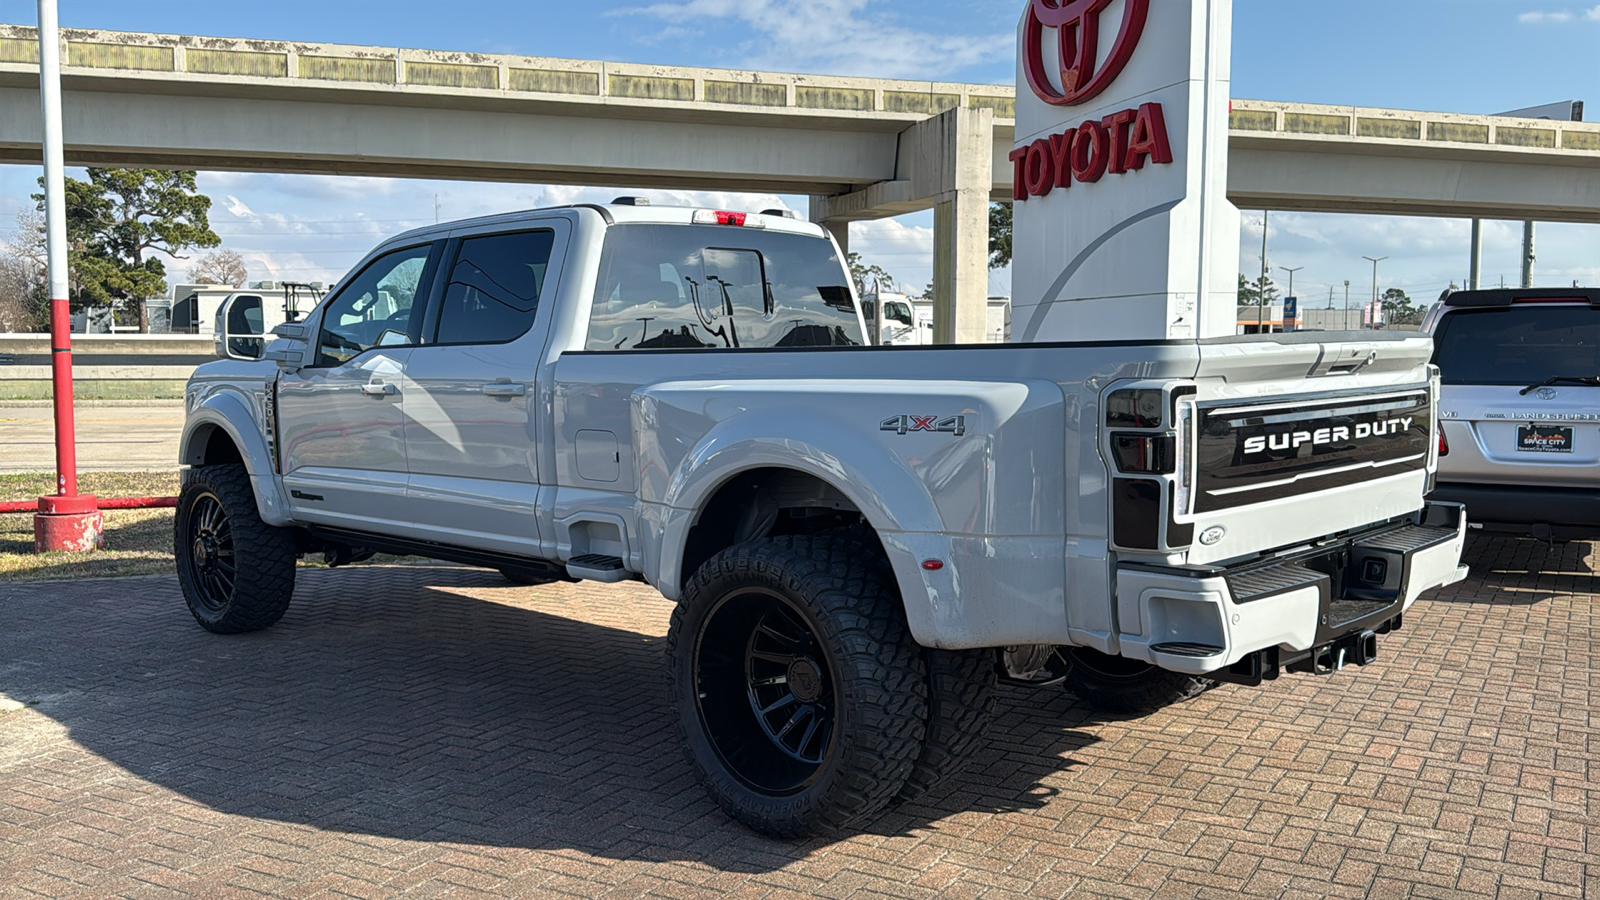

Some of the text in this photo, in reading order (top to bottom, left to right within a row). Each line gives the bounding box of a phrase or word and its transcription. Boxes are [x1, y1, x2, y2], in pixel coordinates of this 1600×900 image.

[1009, 102, 1173, 200] TOYOTA
[1244, 417, 1413, 454] SUPER DUTY
[1524, 437, 1547, 445] SPACE
